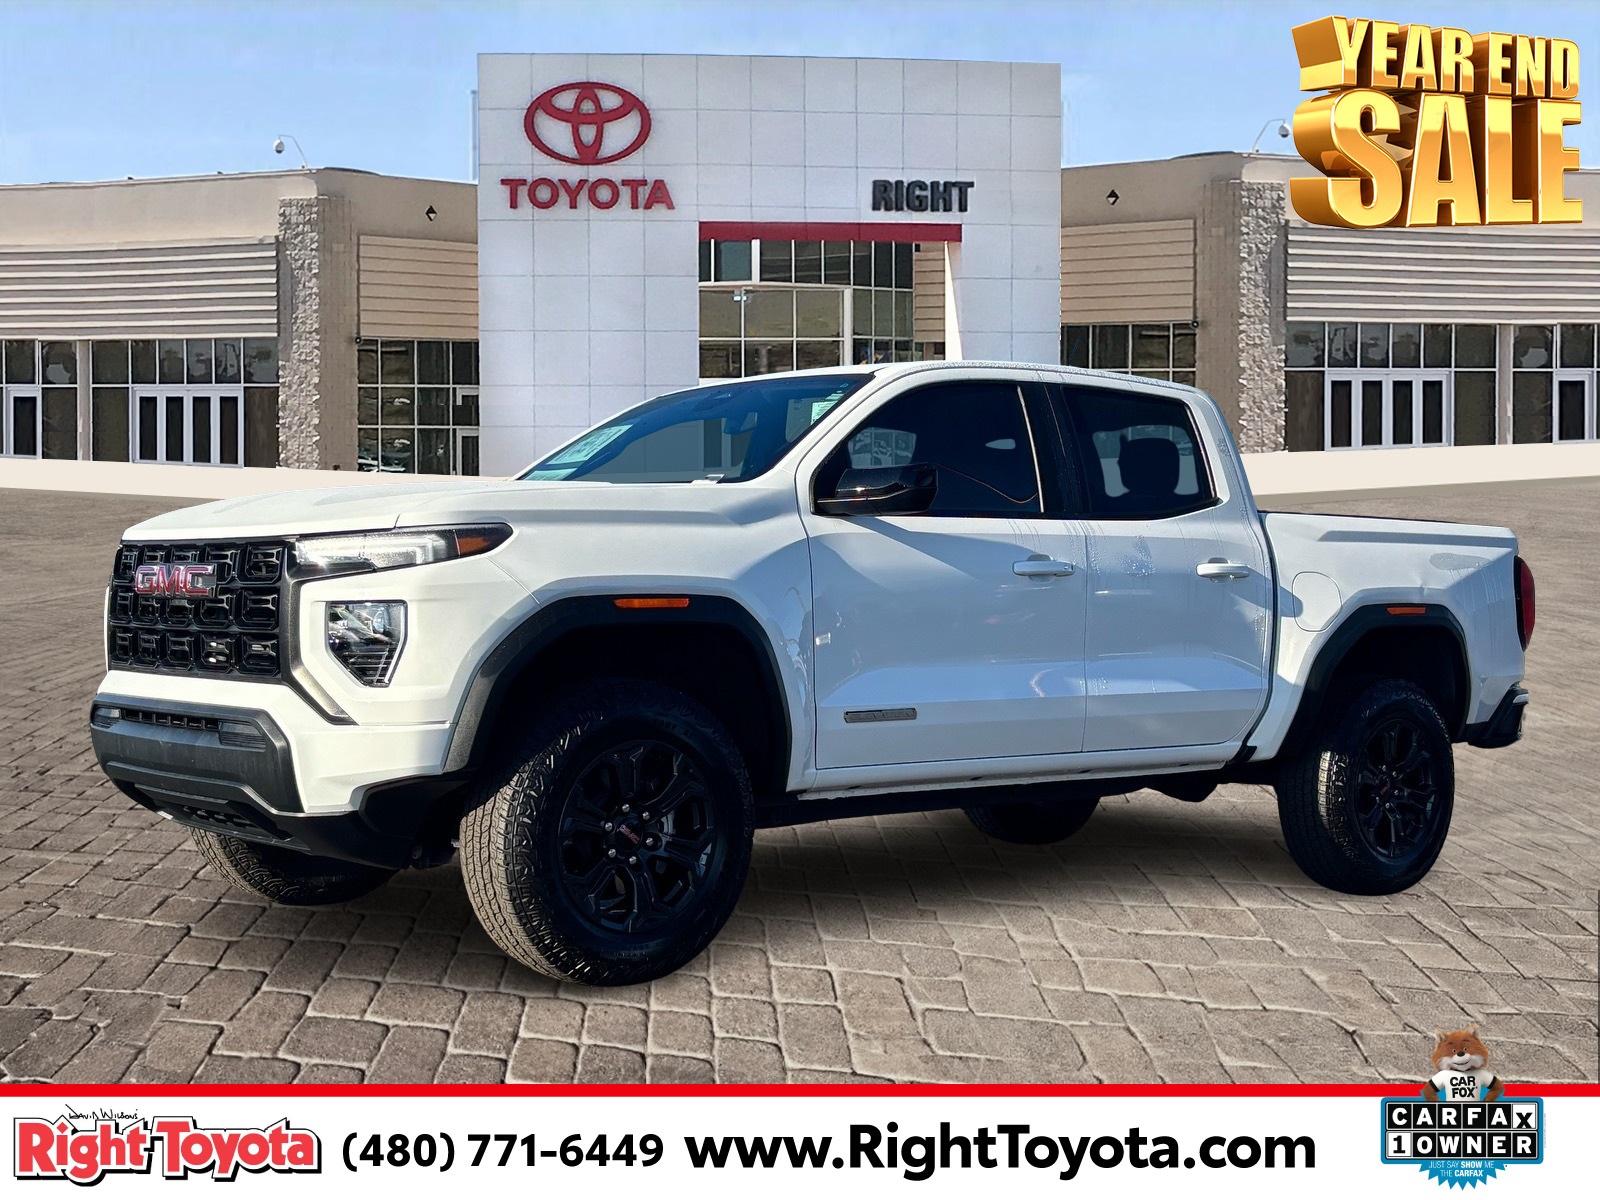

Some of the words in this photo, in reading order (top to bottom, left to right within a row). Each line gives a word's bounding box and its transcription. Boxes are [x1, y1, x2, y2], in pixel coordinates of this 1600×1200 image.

[500, 178, 675, 210] TOYOTA
[871, 179, 975, 213] RIGHT
[136, 564, 214, 597] GMC
